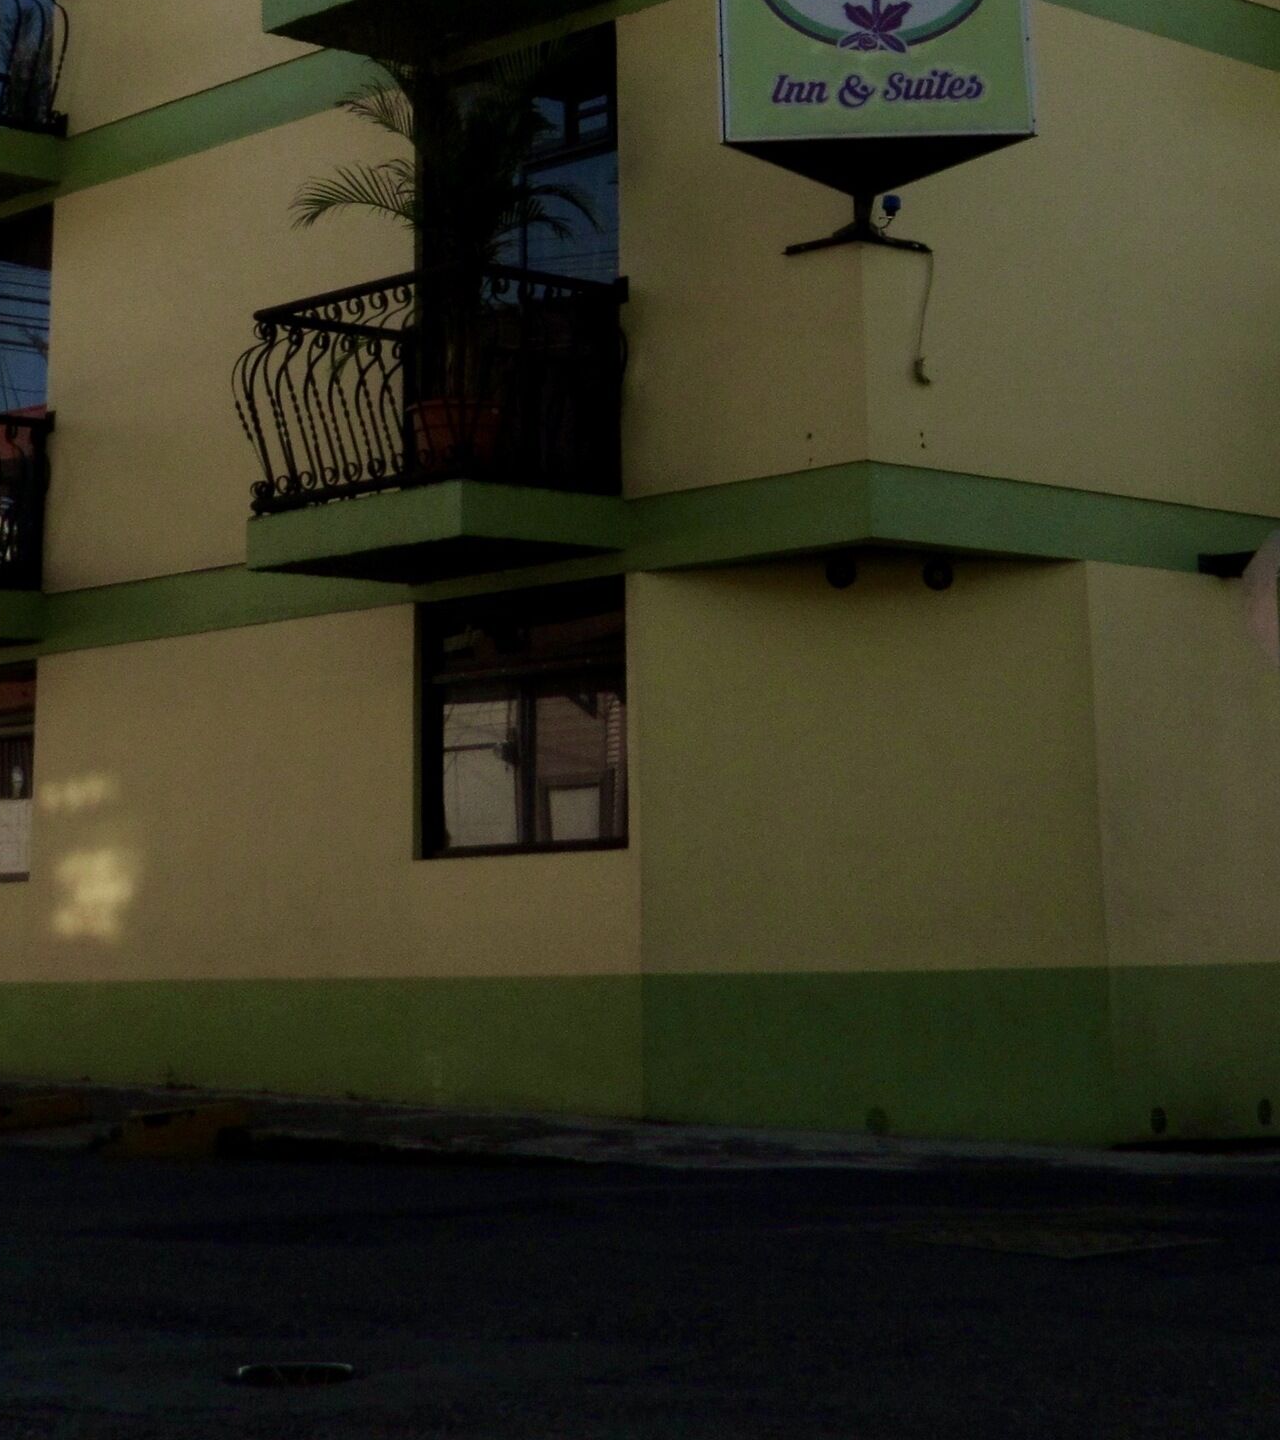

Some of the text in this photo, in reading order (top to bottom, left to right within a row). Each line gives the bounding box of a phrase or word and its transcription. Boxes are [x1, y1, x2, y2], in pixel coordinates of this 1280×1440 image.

[772, 70, 983, 107] Inn & Suites
